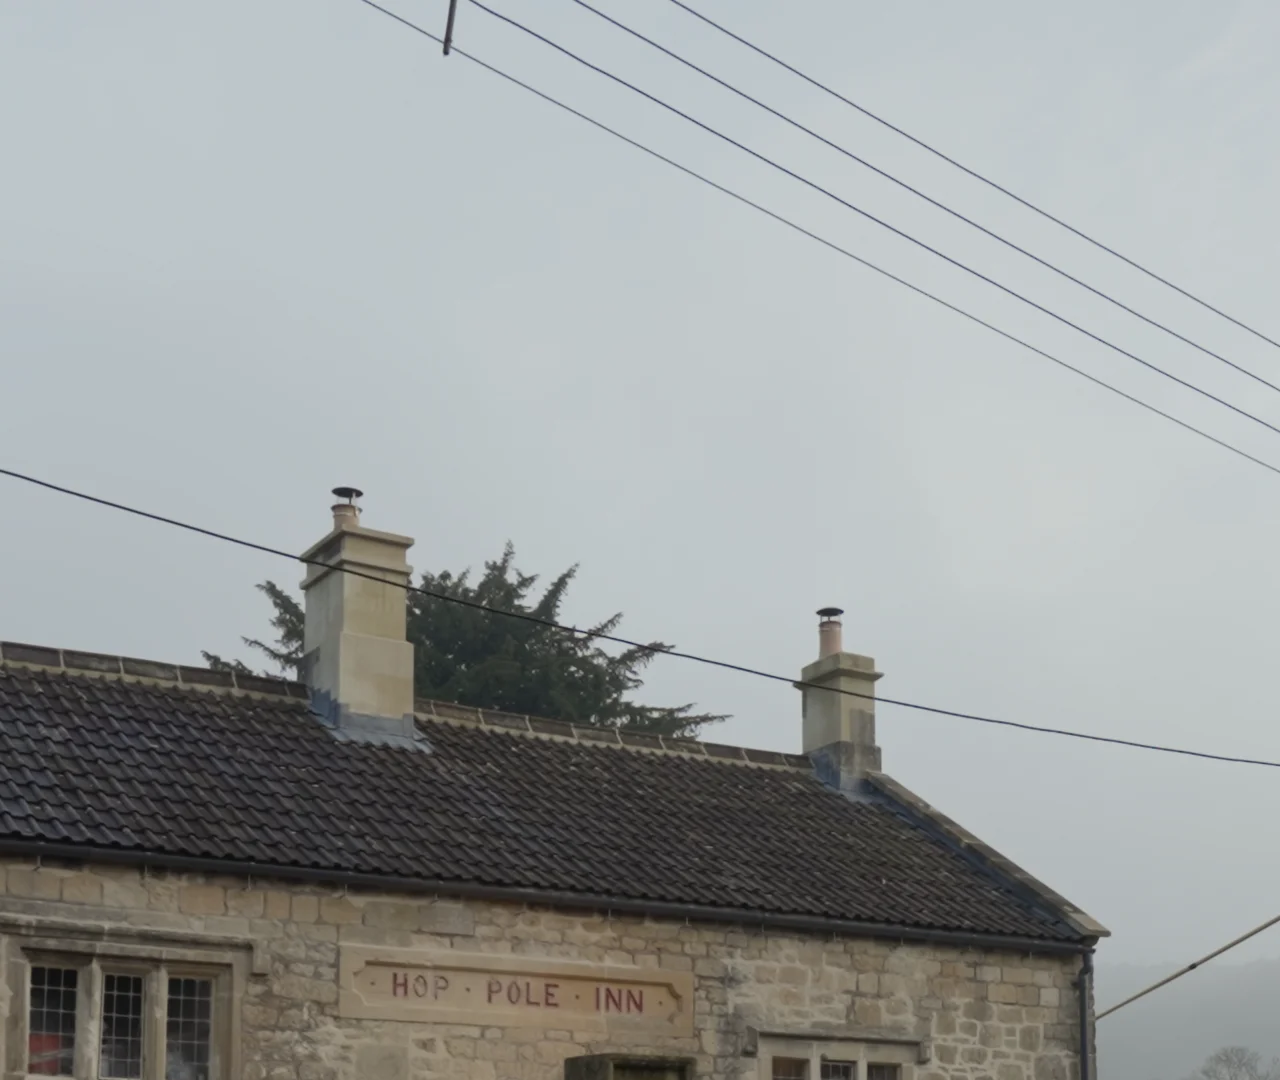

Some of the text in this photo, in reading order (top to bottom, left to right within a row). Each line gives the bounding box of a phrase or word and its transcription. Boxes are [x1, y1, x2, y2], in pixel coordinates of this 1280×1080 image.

[391, 971, 644, 1015] HOP POLE INN
